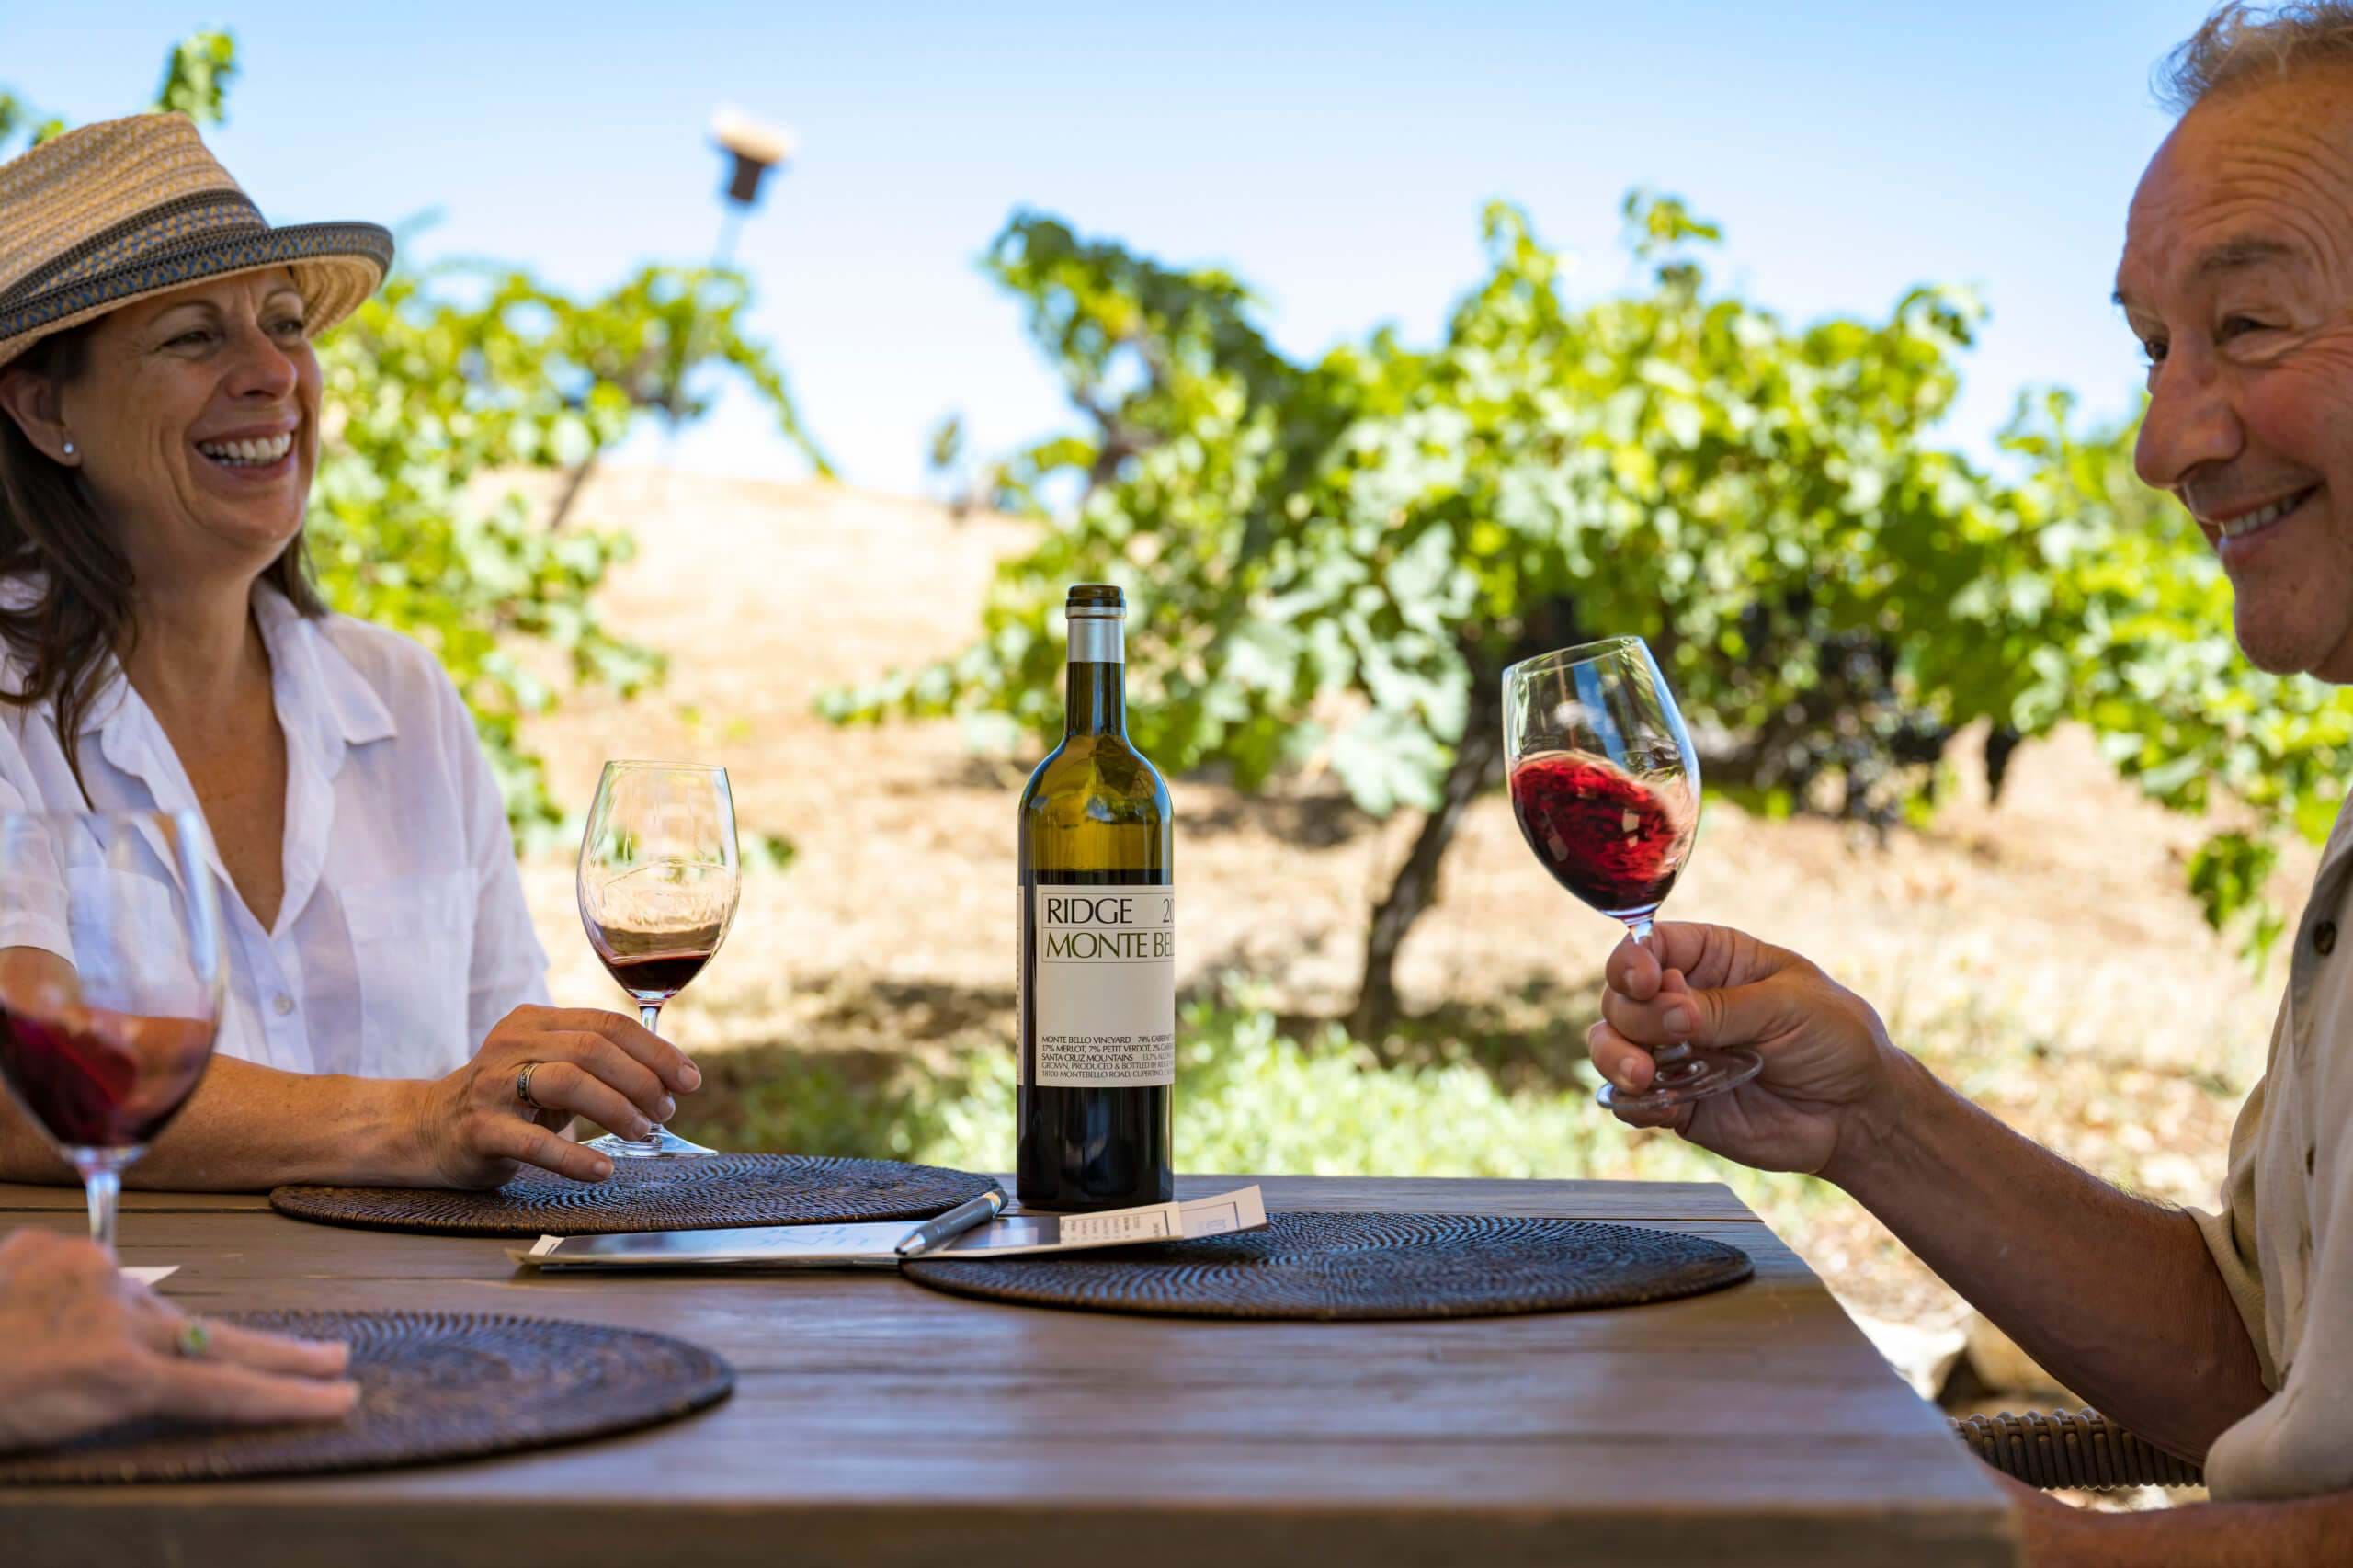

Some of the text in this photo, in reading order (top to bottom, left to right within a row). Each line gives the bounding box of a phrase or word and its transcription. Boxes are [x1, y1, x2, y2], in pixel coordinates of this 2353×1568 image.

[1047, 898, 1132, 924] RIDGE
[1046, 932, 1147, 959] MONTE
[1042, 1036, 1066, 1044] MONTE
[1068, 1036, 1092, 1044] BELLO
[1093, 1036, 1131, 1044] VINEYARD
[1042, 1044, 1054, 1052] 17%
[1055, 1044, 1087, 1053] MERLOT,
[1088, 1045, 1101, 1053] 7%
[1102, 1045, 1122, 1053] PETIT
[1123, 1044, 1151, 1053] VERDOT,
[1041, 1053, 1063, 1062] SANTA
[1064, 1053, 1086, 1062] CRUZ
[1086, 1053, 1133, 1062] MOUNTAINS
[1042, 1062, 1069, 1071] GROWN,
[1059, 1071, 1108, 1079] MONTEBELLO
